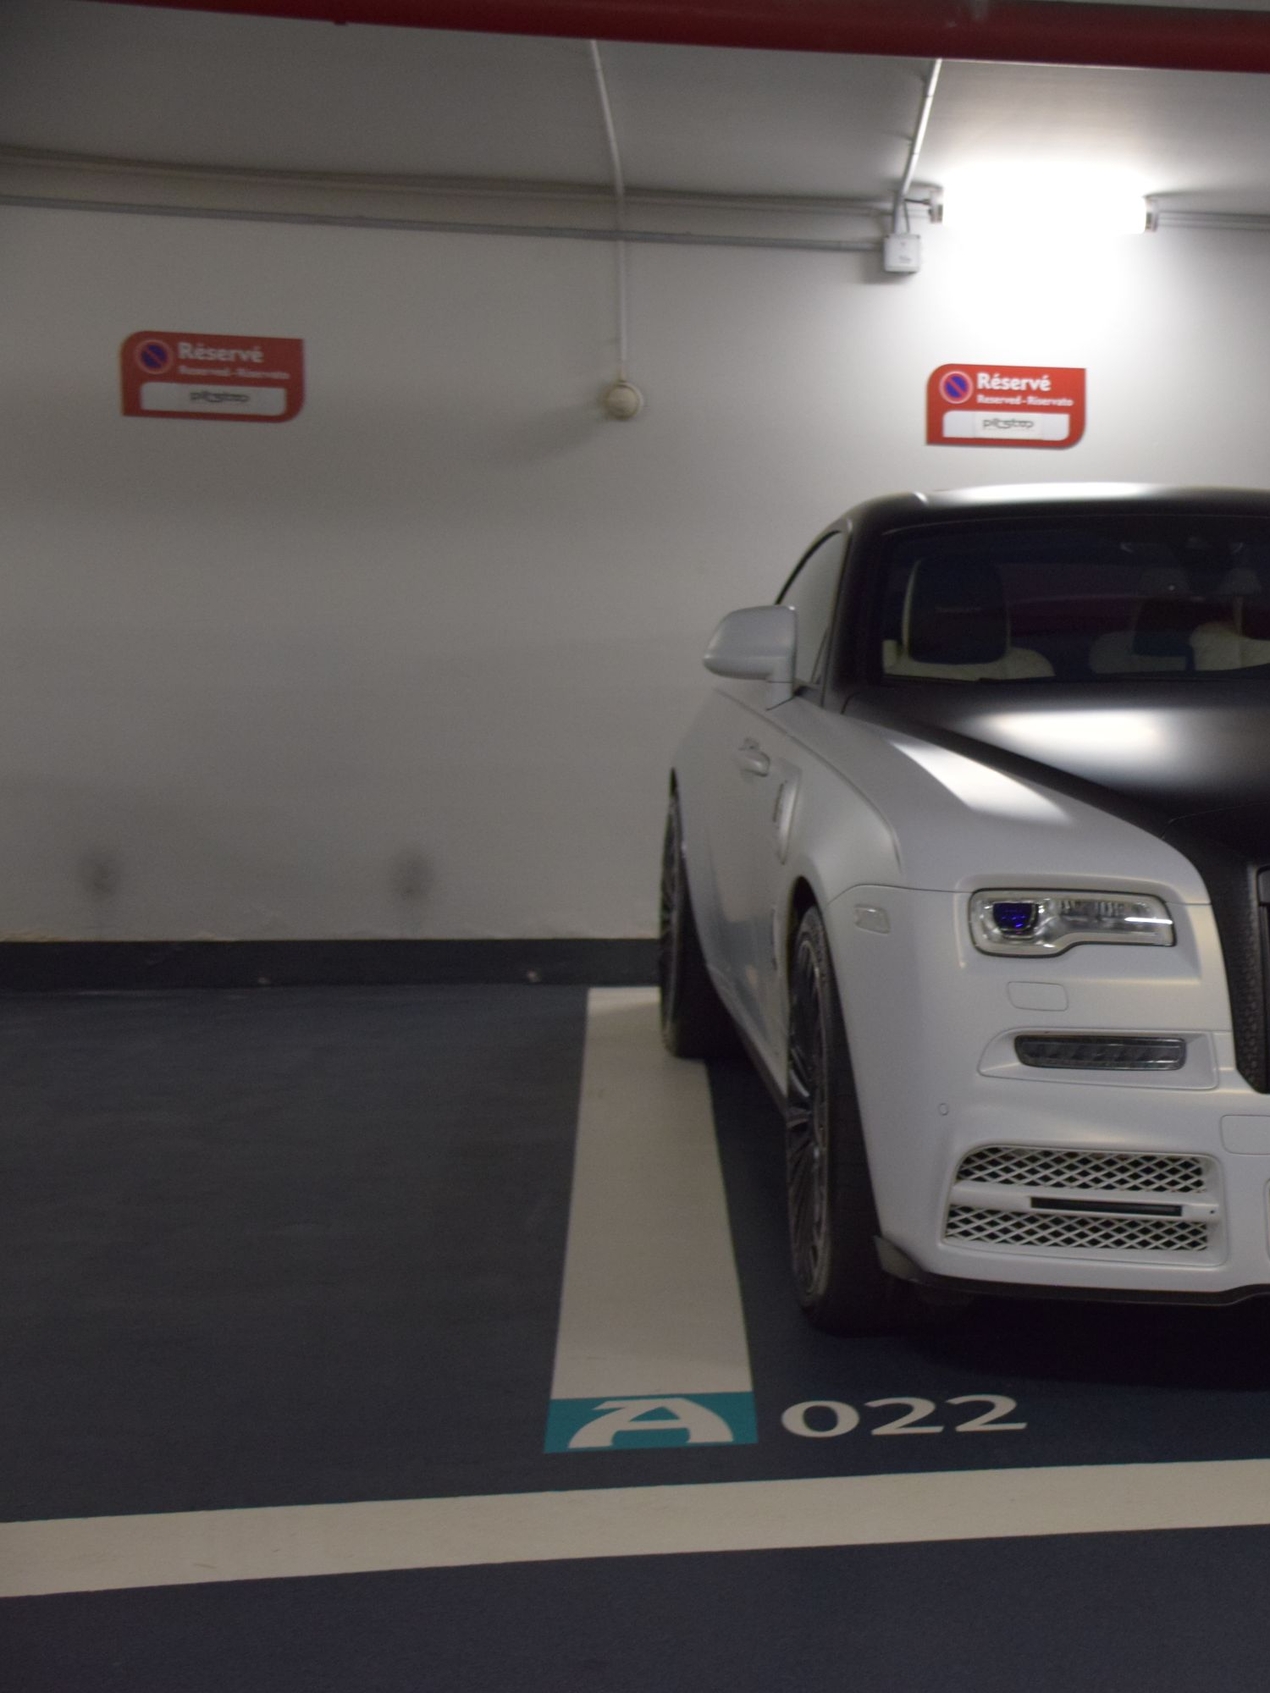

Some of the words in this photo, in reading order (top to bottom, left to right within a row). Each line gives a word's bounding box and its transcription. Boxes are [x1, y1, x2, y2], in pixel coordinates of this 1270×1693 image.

[177, 341, 264, 363] Réservé
[977, 372, 1051, 392] Réservé
[567, 1397, 734, 1449] A
[781, 1394, 1028, 1438] 022
